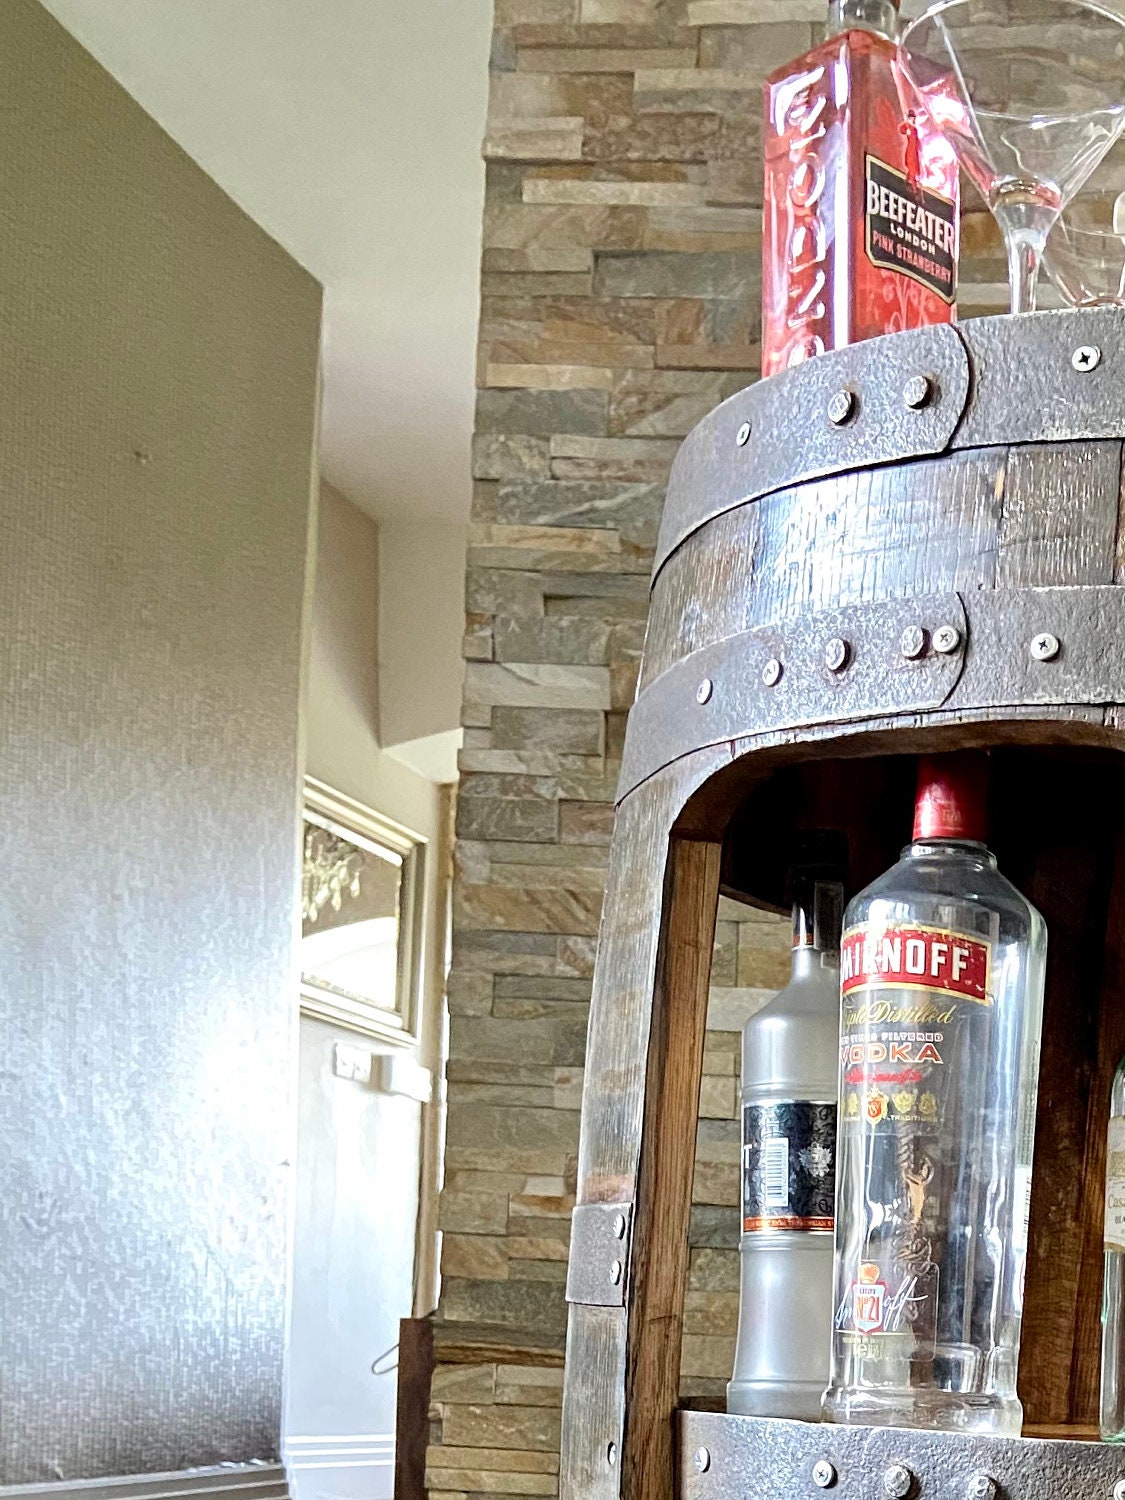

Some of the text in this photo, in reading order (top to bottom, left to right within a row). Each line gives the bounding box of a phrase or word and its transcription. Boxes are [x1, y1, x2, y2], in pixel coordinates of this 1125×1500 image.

[867, 179, 955, 260] BEEFEATER
[889, 222, 936, 255] LONDON
[872, 229, 951, 283] PINK STRAWBERRY
[842, 937, 969, 982] MIRNOFF
[840, 1042, 944, 1066] VODKA
